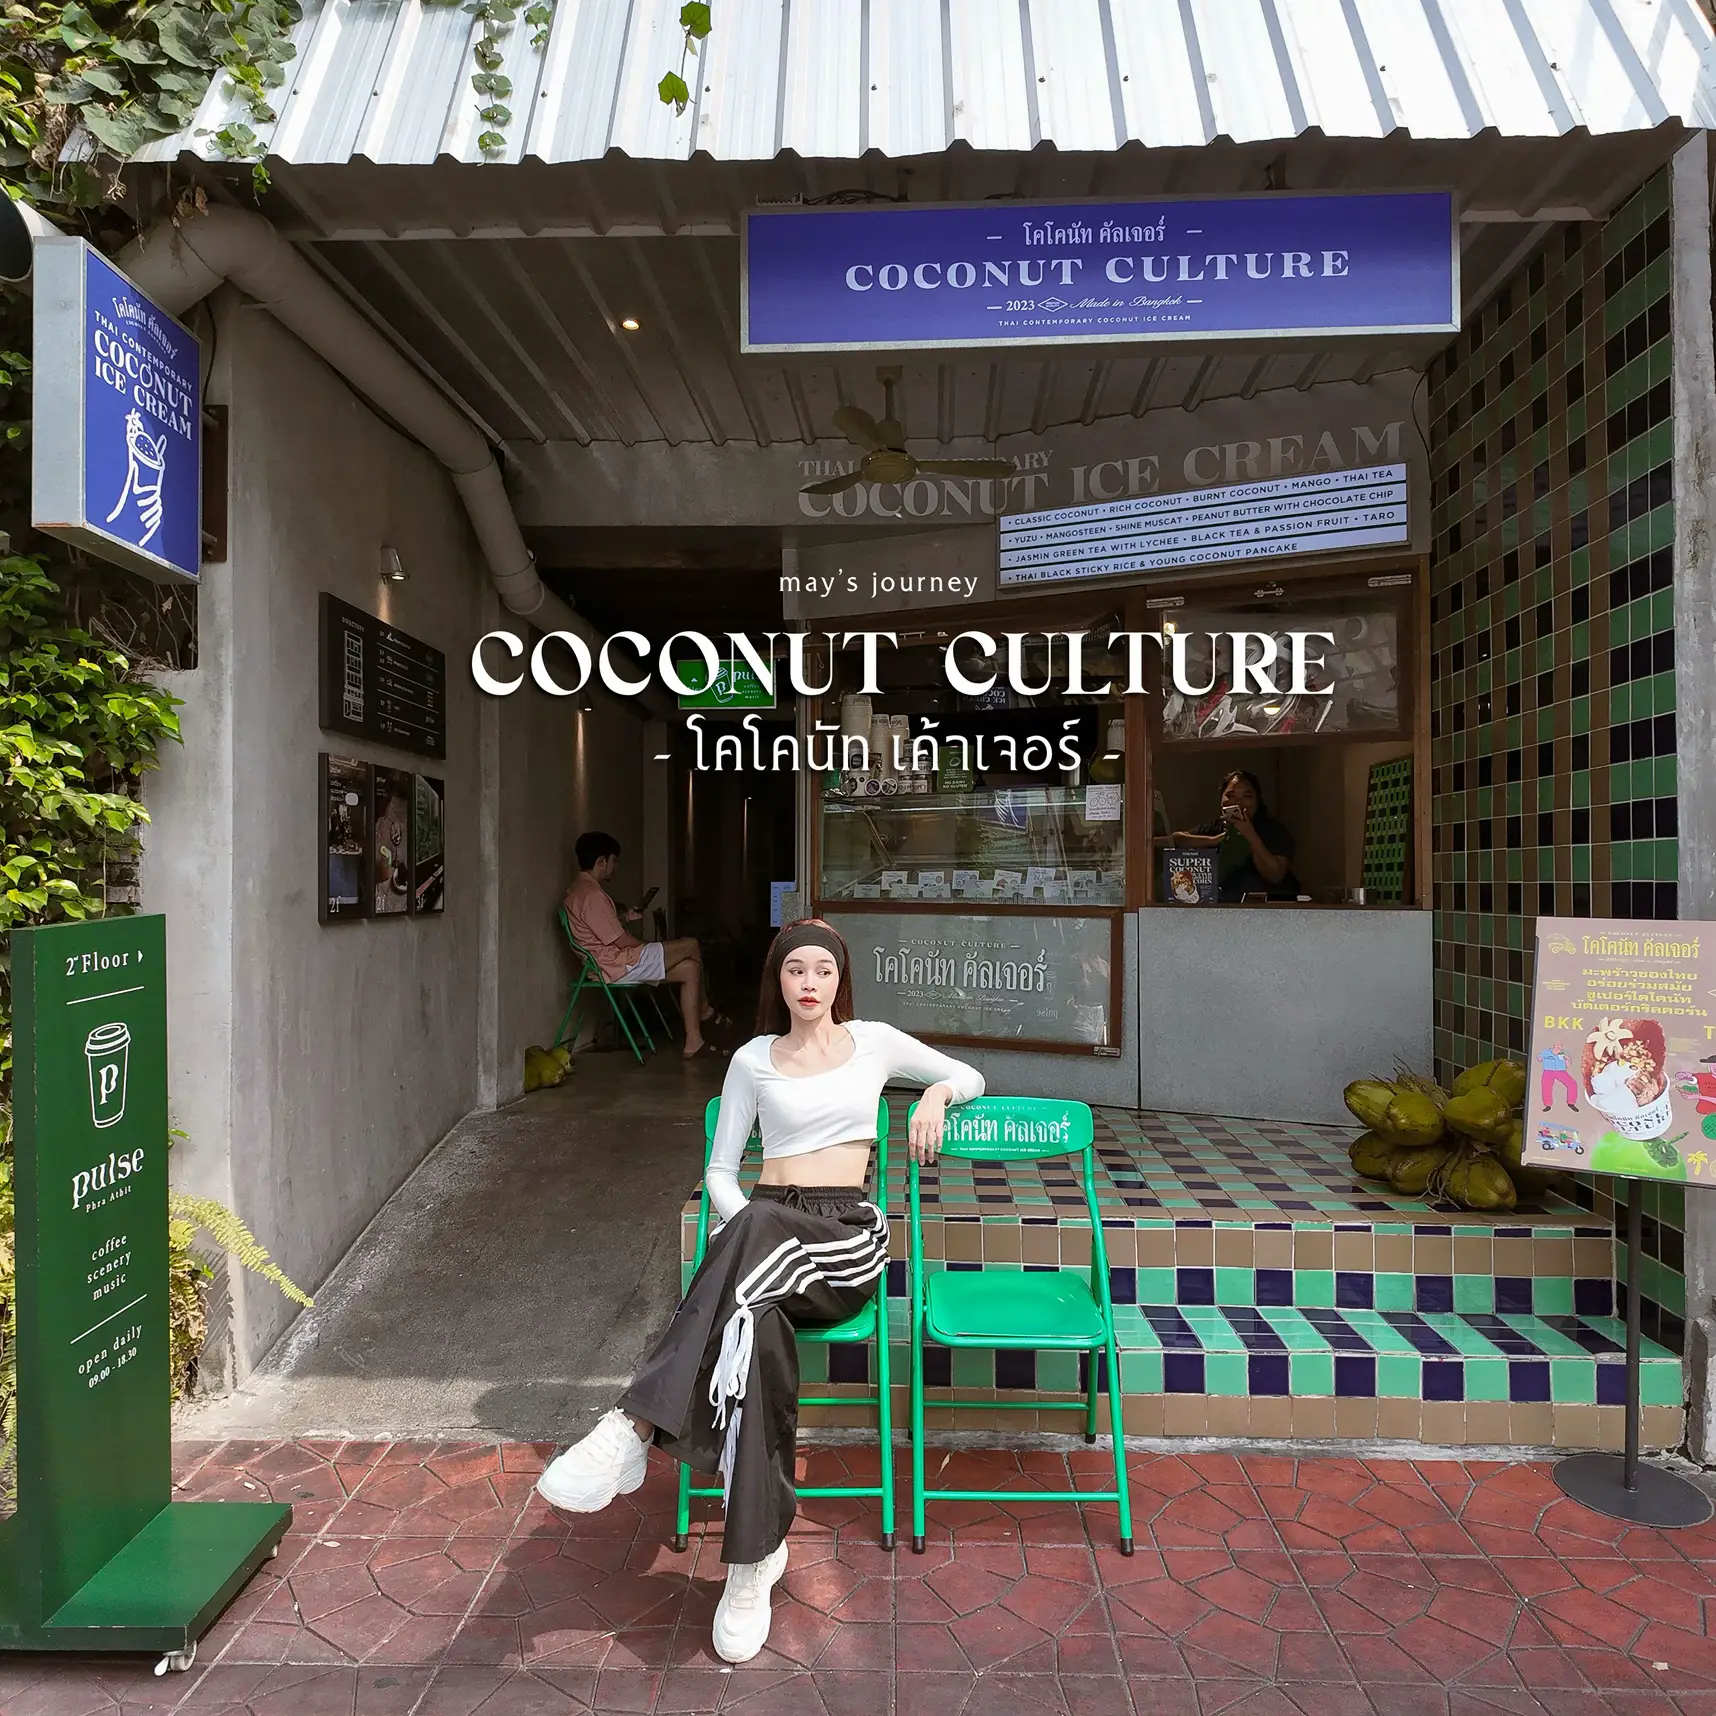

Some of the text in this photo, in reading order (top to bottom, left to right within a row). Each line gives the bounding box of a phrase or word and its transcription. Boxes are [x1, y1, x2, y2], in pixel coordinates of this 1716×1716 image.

[1023, 216, 1166, 246] โคโคนัท คัลเจอร์
[846, 250, 1349, 292] COCONUT CULTURE
[1006, 300, 1035, 312] 2023
[1070, 297, 1110, 308] Made
[1112, 300, 1124, 308] in
[1129, 296, 1182, 310] Bangkok
[1022, 318, 1093, 326] CONTEMPORARY
[1098, 316, 1138, 324] COCONUT
[1162, 314, 1192, 322] CREAM
[95, 310, 118, 336] THAI
[122, 332, 193, 392] CONTEMPORARY
[94, 329, 193, 418] COCONUT
[94, 355, 192, 441] ICE CREAM
[798, 460, 855, 477] THAI
[798, 473, 1049, 518] COCONUT
[1070, 454, 1161, 504] ICE
[1183, 421, 1406, 487] CREAM
[1014, 470, 1394, 526] CLASSIC COCONUT RICH COCONUT BURNT COCONUT MANGO THAI TEA
[1014, 490, 1394, 544] YUZU MANGOSTEEN SHINE MUSCAT PEANUT BUTTER WITH CHOCOLATE CHIP
[1016, 511, 1396, 563] JASMIN GREEN TEA WITH LYCHEE BLACK TEA & PASSION FRUIT TARO
[1016, 542, 1298, 582] THAI BLACK STICKY RICE & YOUNG COCONUT PANCAKE
[1169, 858, 1212, 866] SUPER
[82, 951, 130, 974] Floor
[1582, 935, 1700, 958] โคโคนัท คัลเจอร์
[873, 946, 1048, 992] โคโคนัท คัลเจอร์
[1582, 967, 1698, 980] มะพร้าวของไทย
[1586, 977, 1692, 992] อร่อยร่วมสมัย
[907, 990, 924, 998] 2023
[1544, 1015, 1584, 1031] BKK
[942, 1110, 1072, 1144] คโคนัท คัลเจอร์
[72, 1146, 145, 1210] pulse
[86, 1184, 132, 1214] Phra Athit
[91, 1234, 128, 1262] coffee
[87, 1250, 132, 1284] scenery
[92, 1271, 128, 1301] music
[78, 1323, 142, 1375] open daily
[88, 1366, 110, 1389] 09.00
[117, 1346, 138, 1368] 18.30
